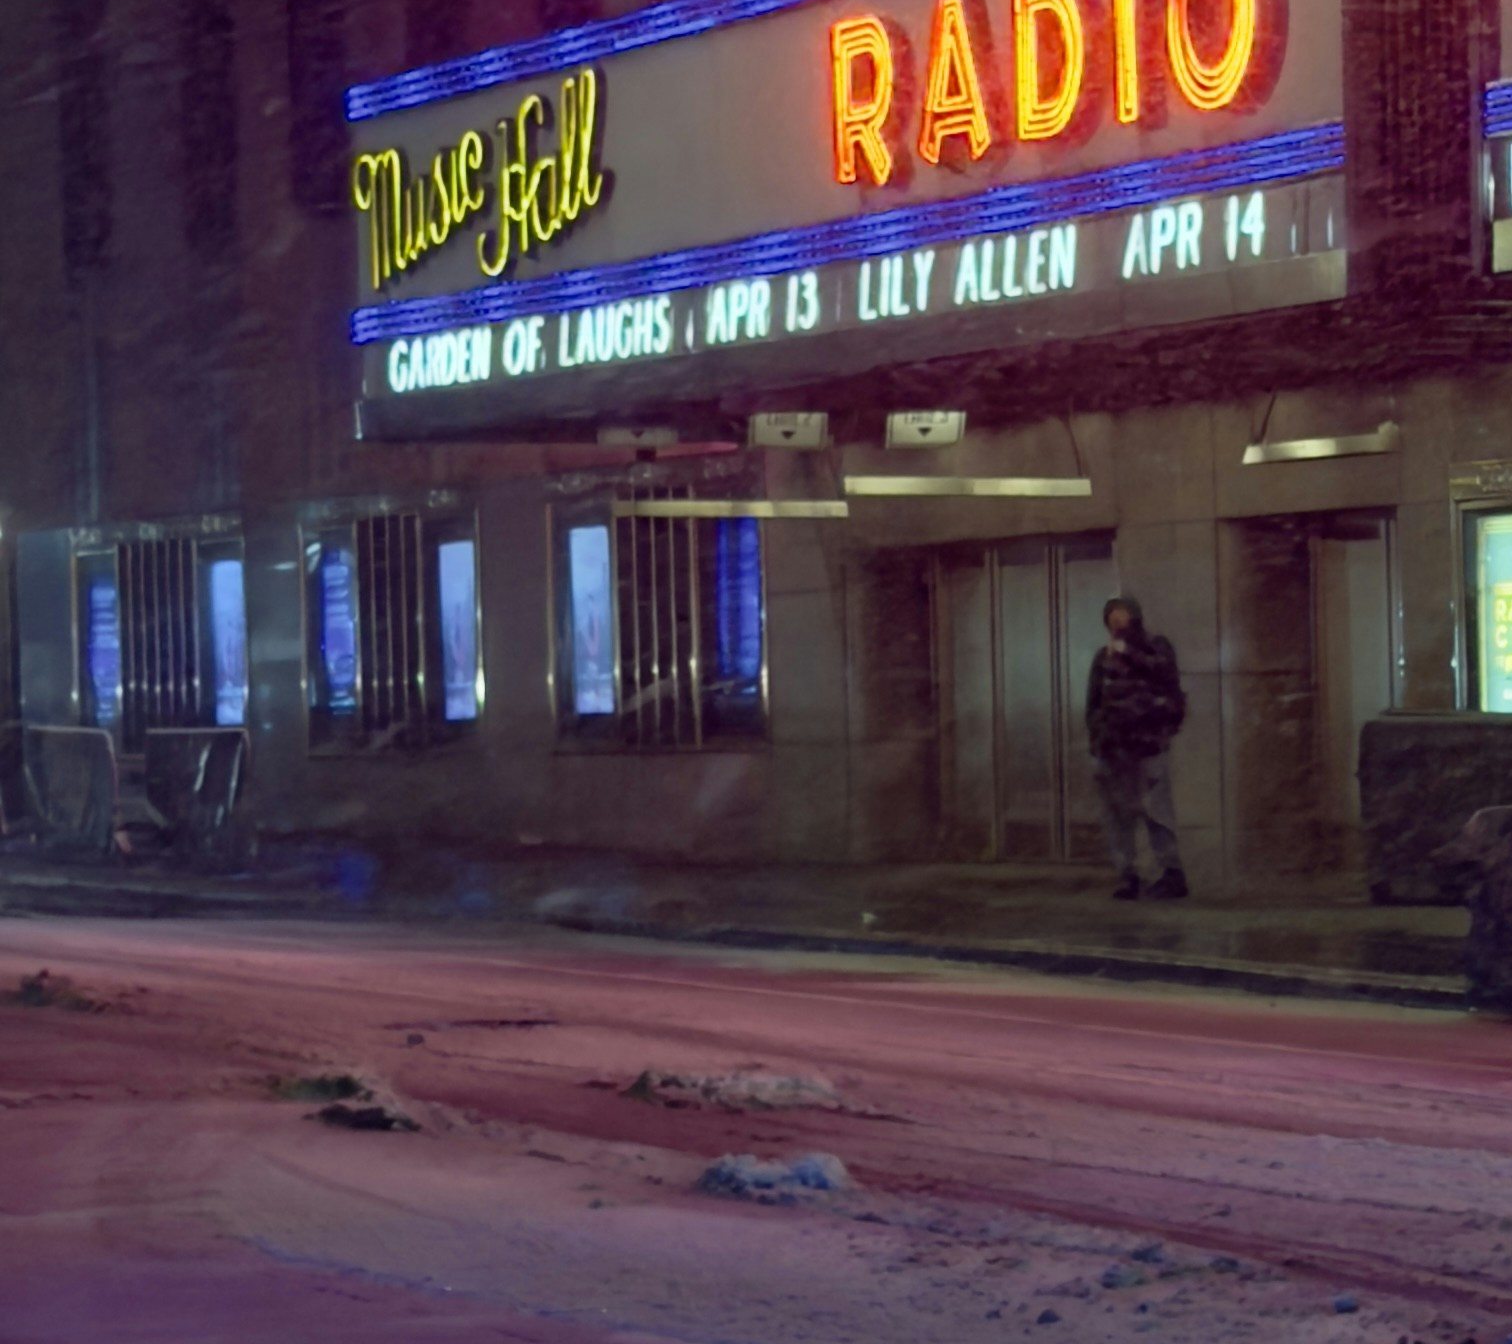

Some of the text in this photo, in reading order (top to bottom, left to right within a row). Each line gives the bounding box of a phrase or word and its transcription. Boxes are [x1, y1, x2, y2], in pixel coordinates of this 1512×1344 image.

[388, 190, 1266, 393] GARDEN OF LAUGHS APR 13 LILY ALLEN APR 14
